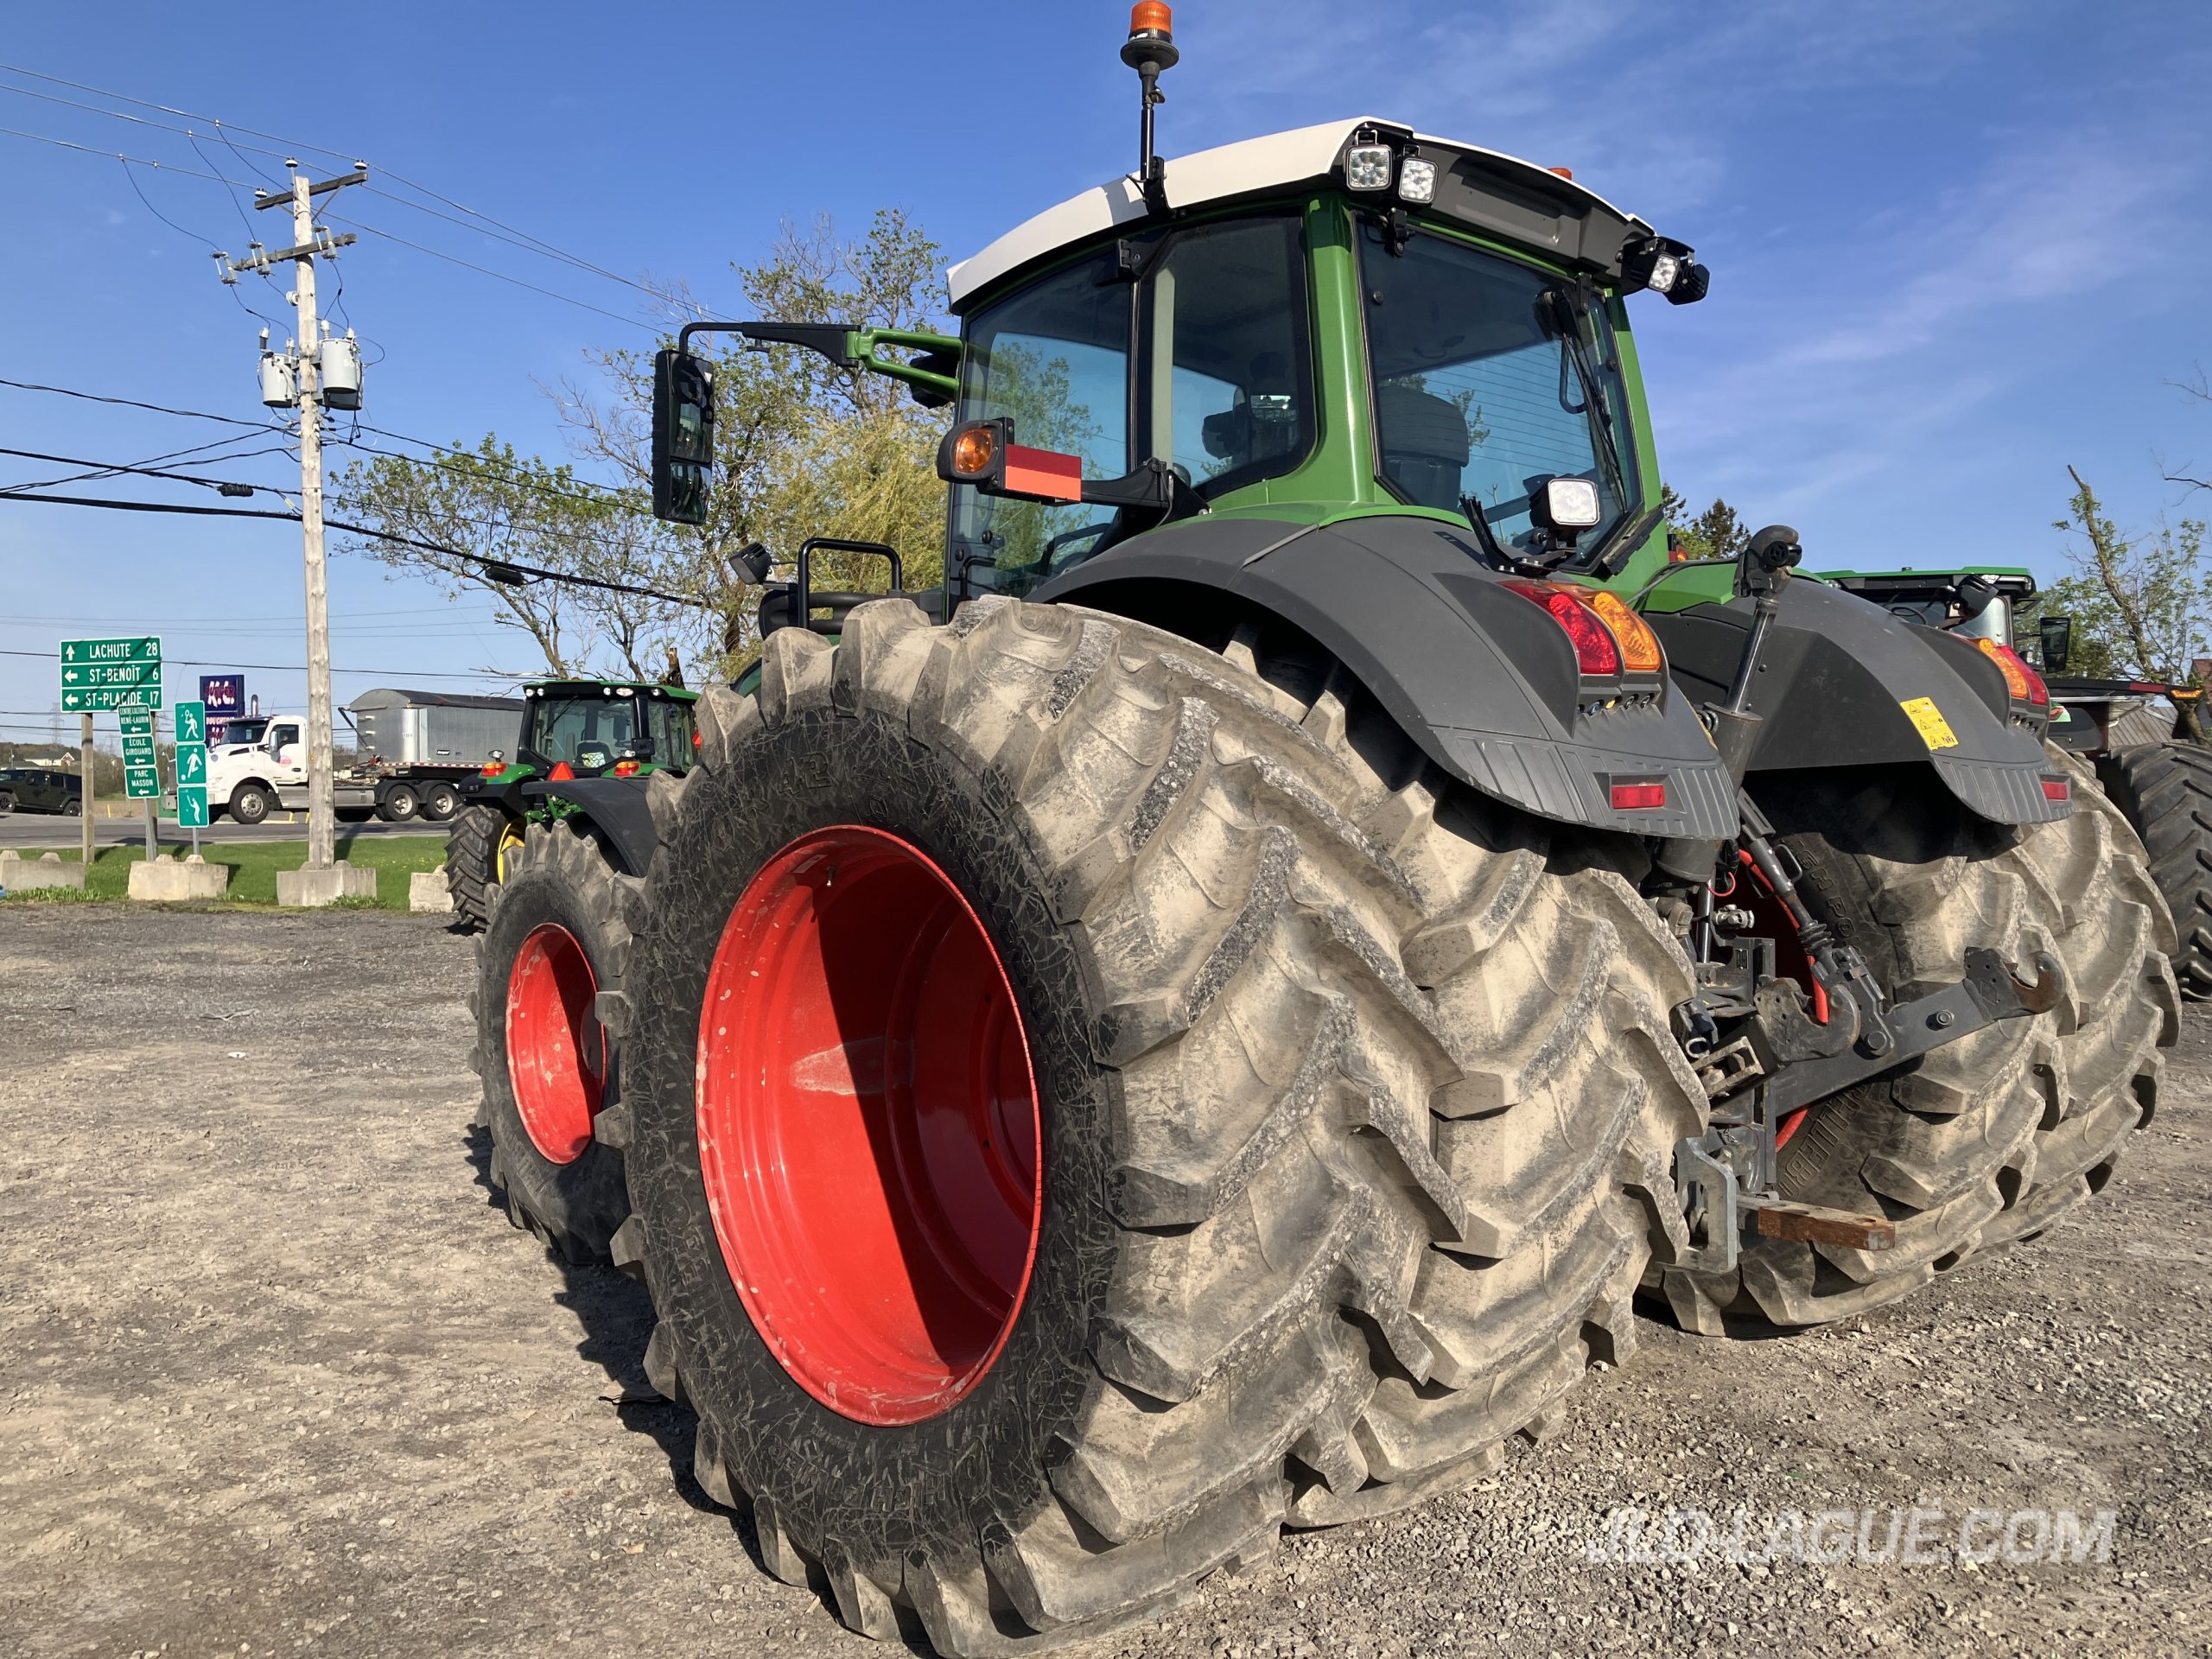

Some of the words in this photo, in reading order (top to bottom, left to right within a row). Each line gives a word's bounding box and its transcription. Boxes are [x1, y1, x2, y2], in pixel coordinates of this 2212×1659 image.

[89, 643, 131, 658] LACHUTE
[145, 642, 158, 657] 28
[89, 664, 141, 683] ST-BENOÎT
[152, 668, 159, 681] 6
[86, 691, 143, 707] ST-PLACIDE
[149, 690, 159, 705] 17
[125, 747, 152, 756] GIROUARD
[131, 779, 154, 787] MASSON
